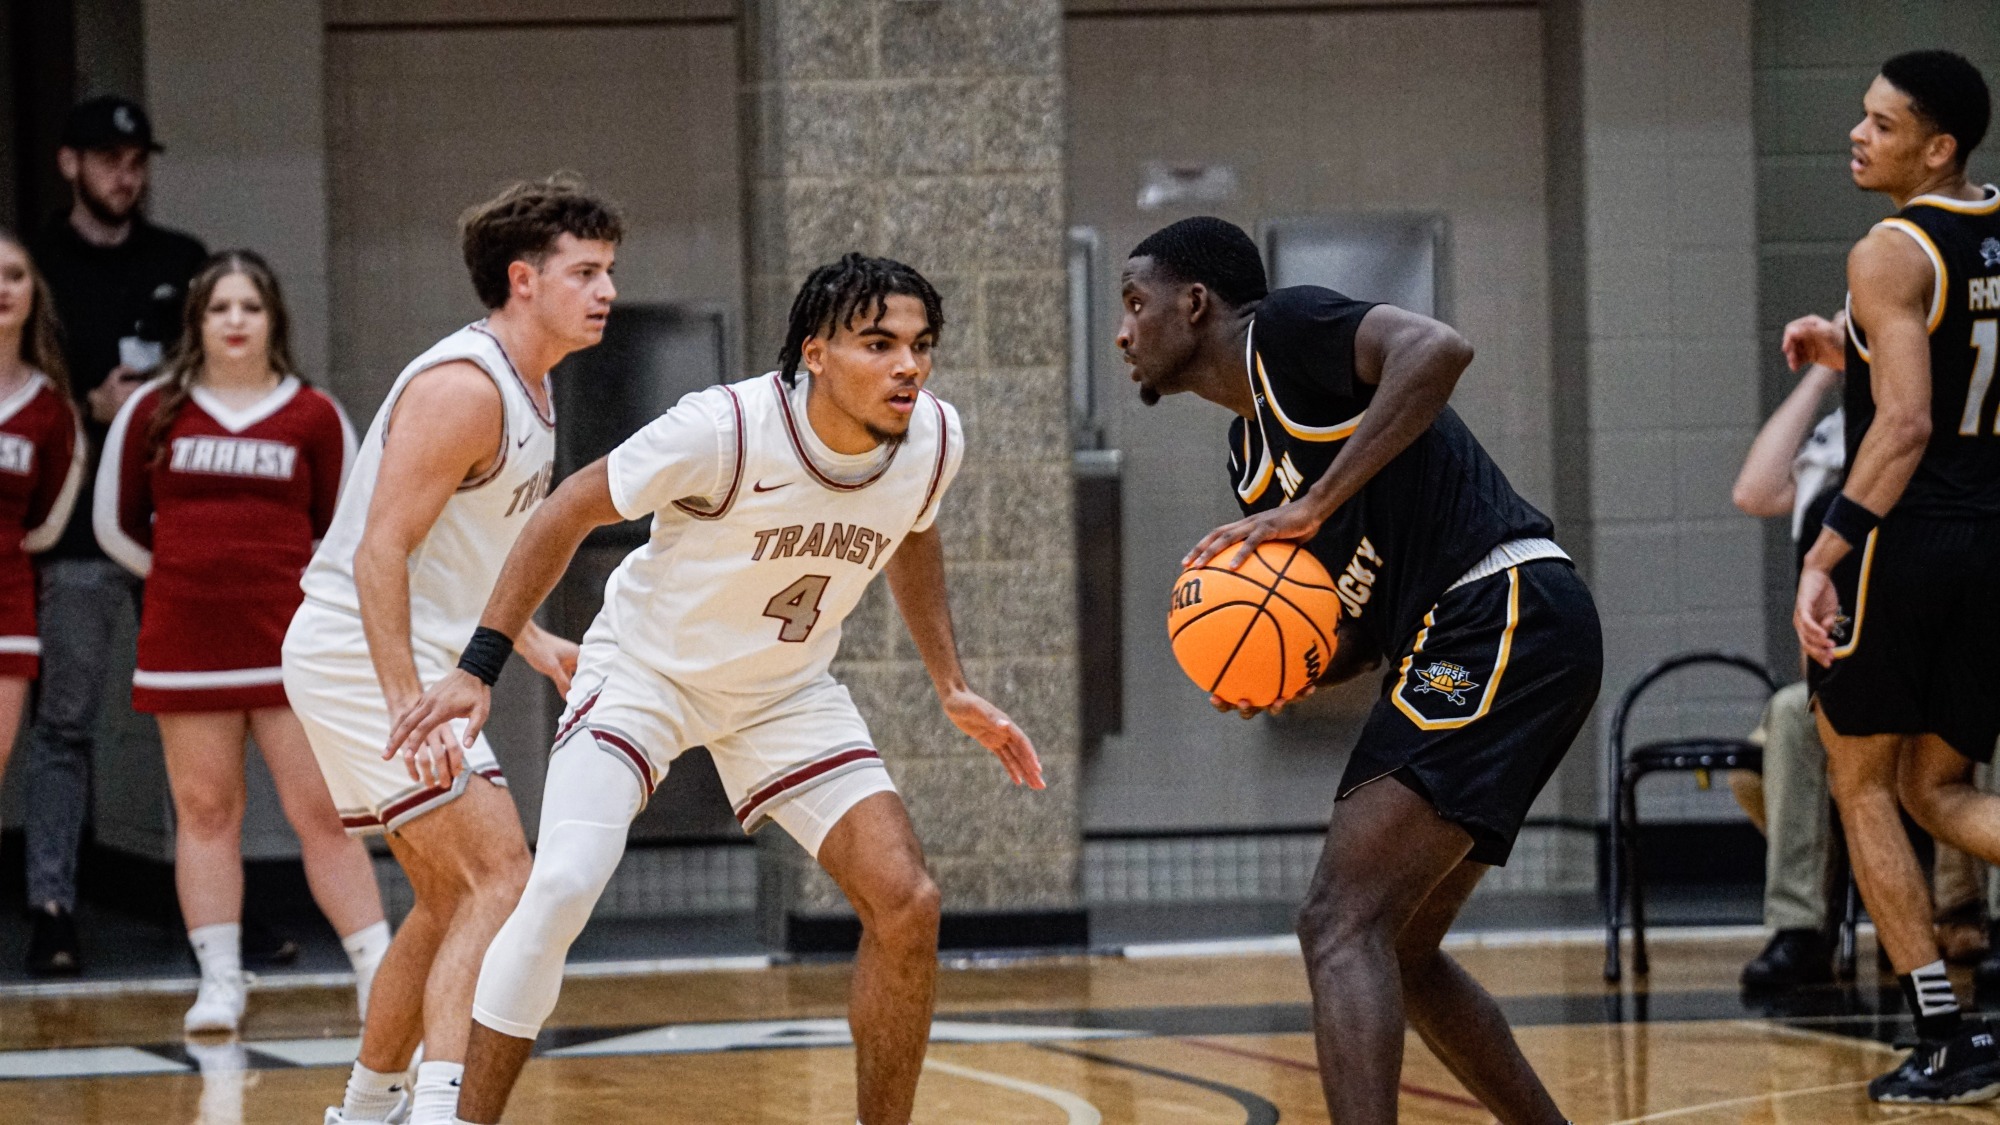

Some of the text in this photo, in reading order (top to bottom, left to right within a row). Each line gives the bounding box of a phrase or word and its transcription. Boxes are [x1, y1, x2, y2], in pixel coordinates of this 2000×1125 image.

[169, 434, 297, 480] TRANSY
[751, 522, 891, 570] TRANSY
[762, 573, 831, 642] 4
